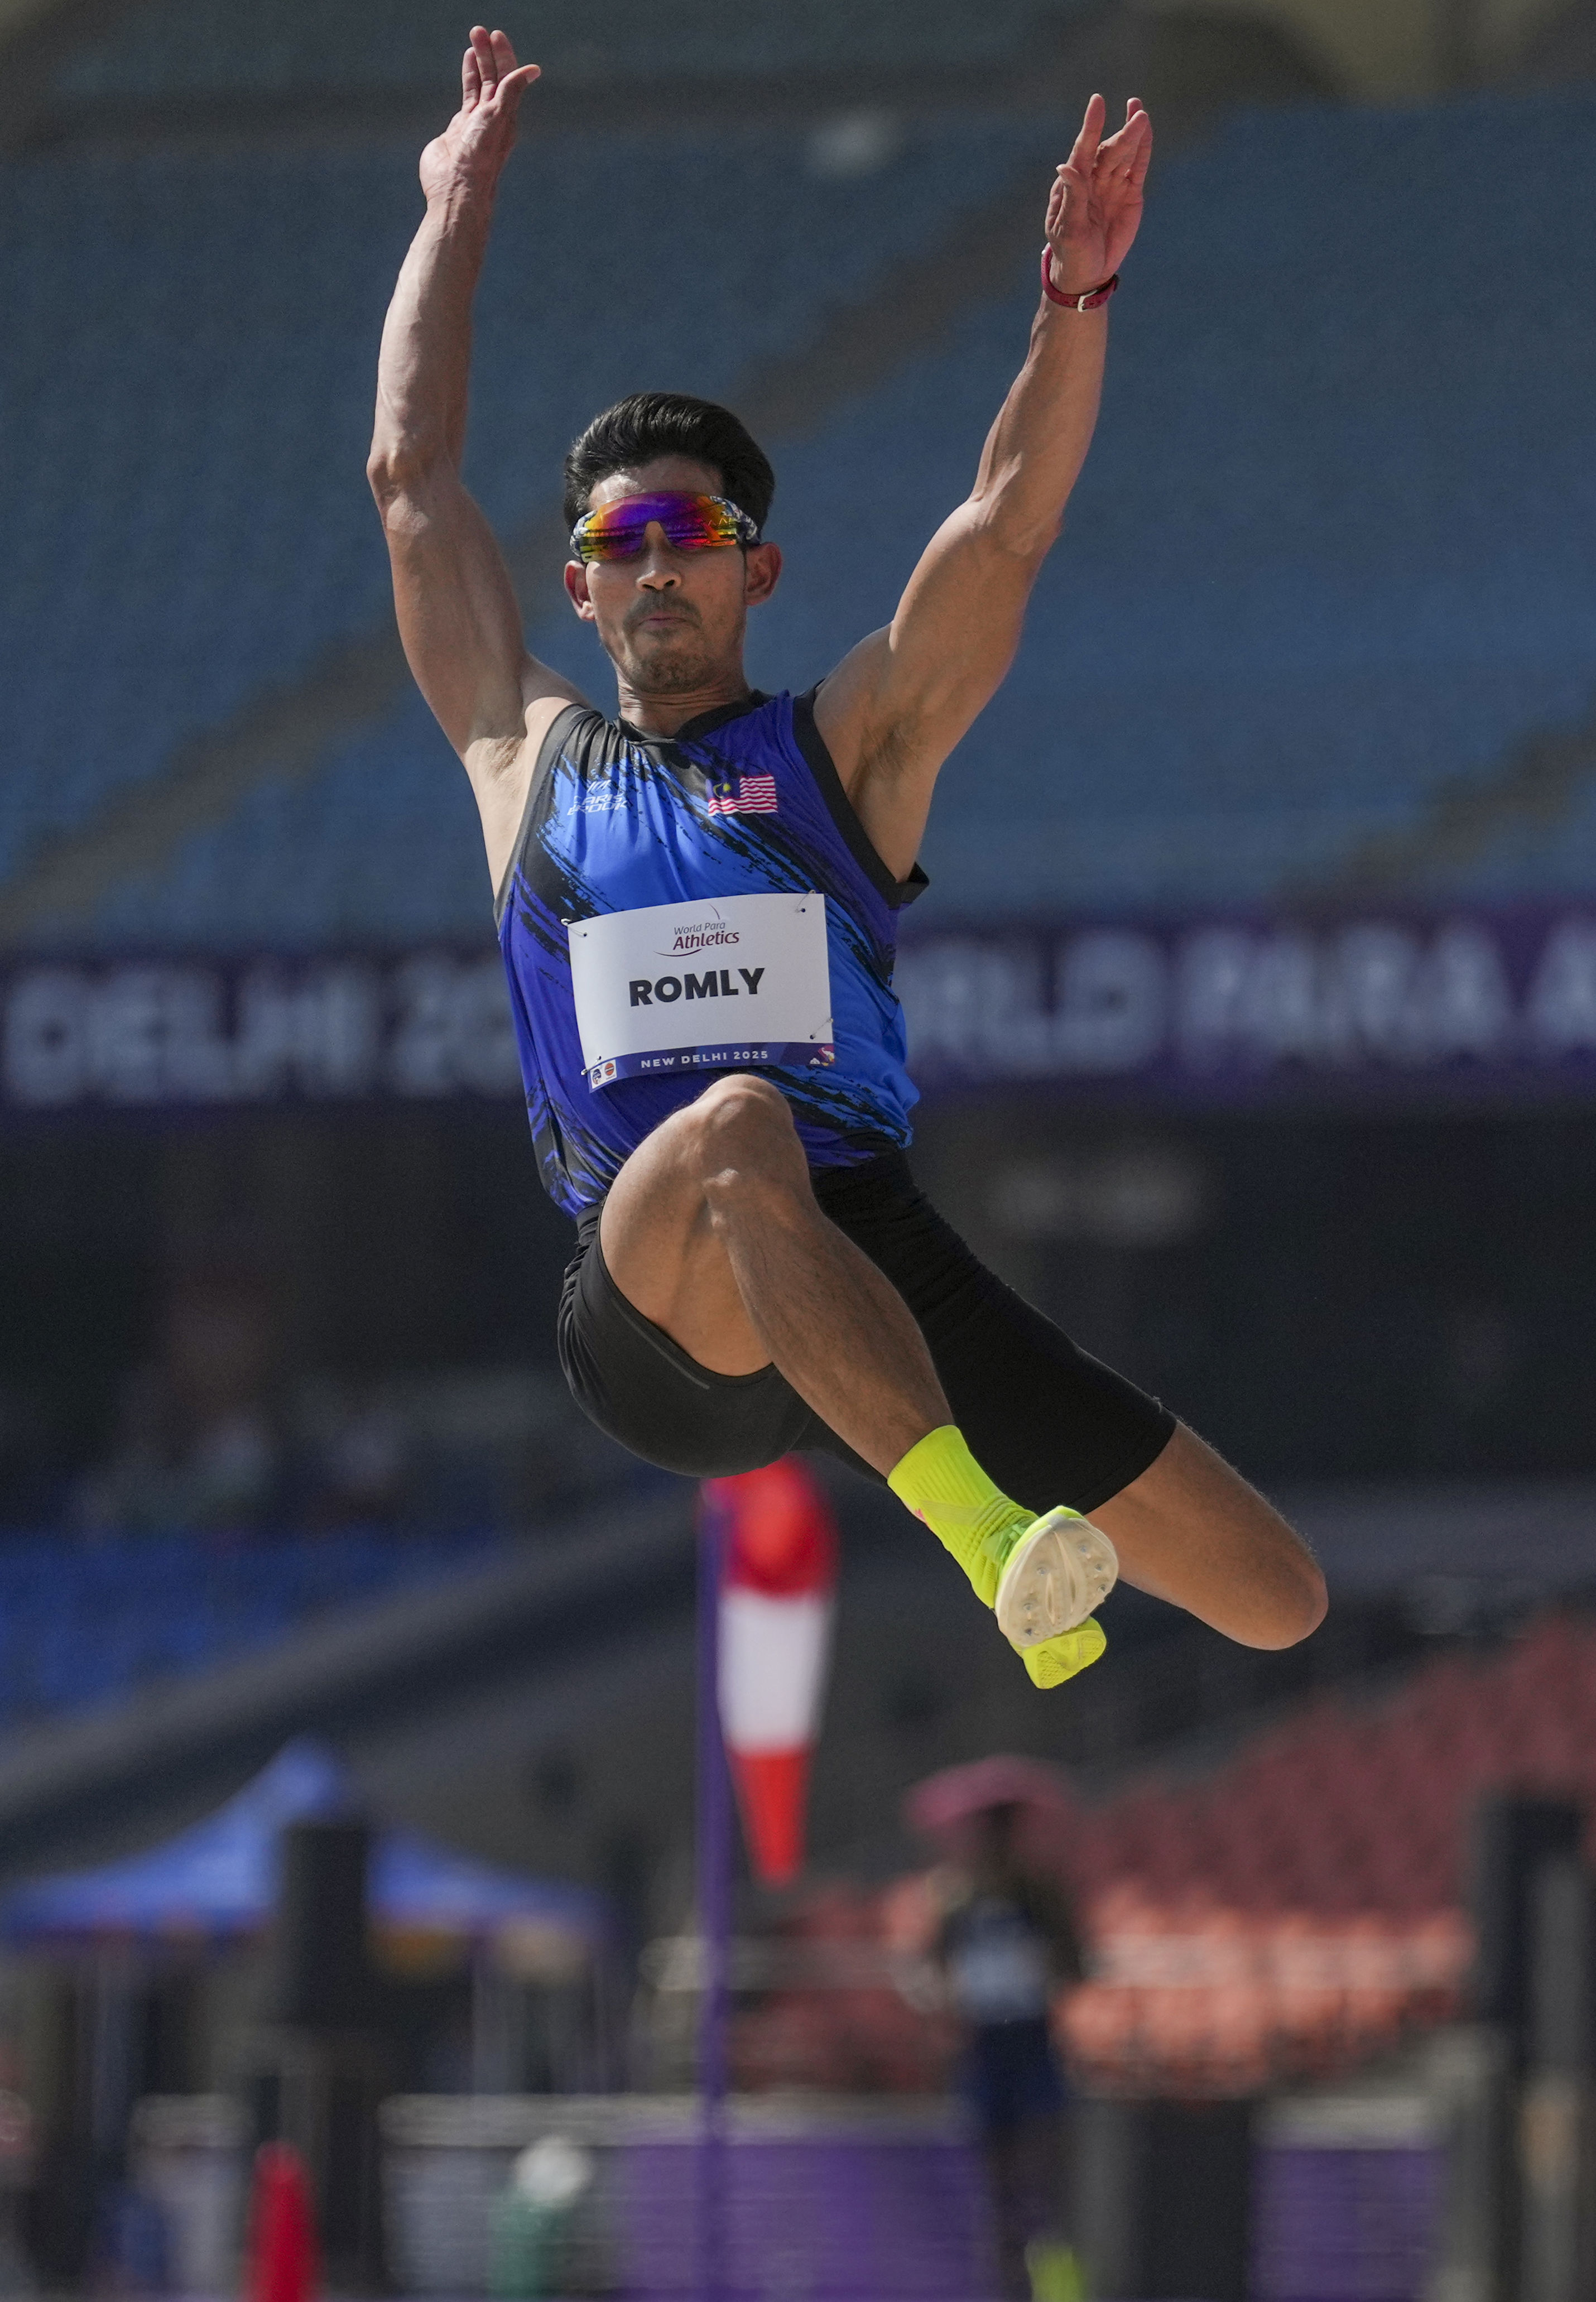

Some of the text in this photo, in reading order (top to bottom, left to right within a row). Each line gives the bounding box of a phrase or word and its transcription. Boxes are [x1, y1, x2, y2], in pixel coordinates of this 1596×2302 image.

[674, 922, 725, 935] World Para
[672, 930, 739, 950] Athletics
[629, 967, 766, 1007] ROMLY
[641, 1050, 768, 1068] NEW DELHI 2025
